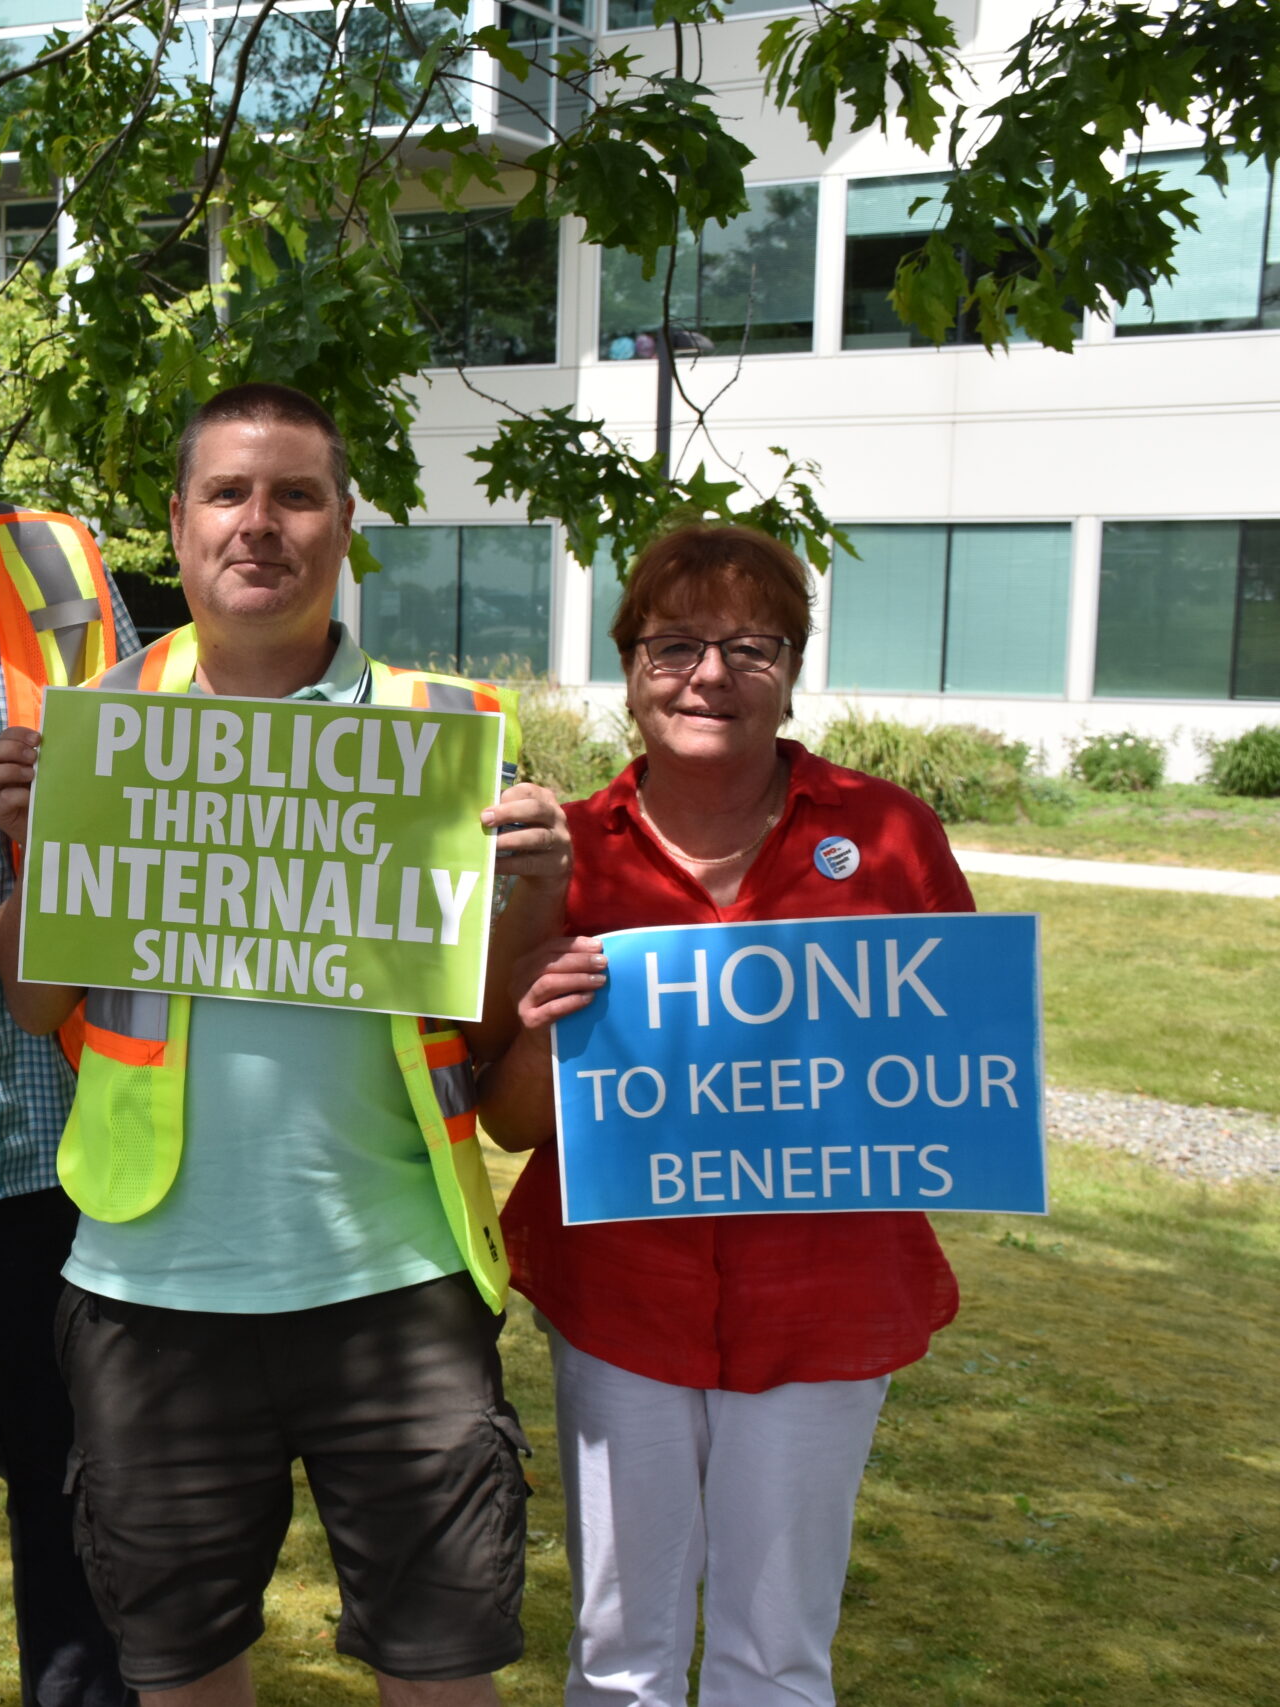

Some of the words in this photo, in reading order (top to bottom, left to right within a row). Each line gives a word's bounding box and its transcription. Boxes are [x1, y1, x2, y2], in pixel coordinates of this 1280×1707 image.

[95, 703, 441, 797] PUBLICLY
[123, 786, 393, 865] THRIVING,
[40, 841, 480, 946] INTERNALLY
[132, 929, 363, 999] SINKING.
[645, 937, 948, 1029] HONK
[577, 1066, 666, 1121] TO
[689, 1057, 845, 1115] KEEP
[867, 1055, 1019, 1108] OUR
[650, 1144, 954, 1204] BENEFITS
